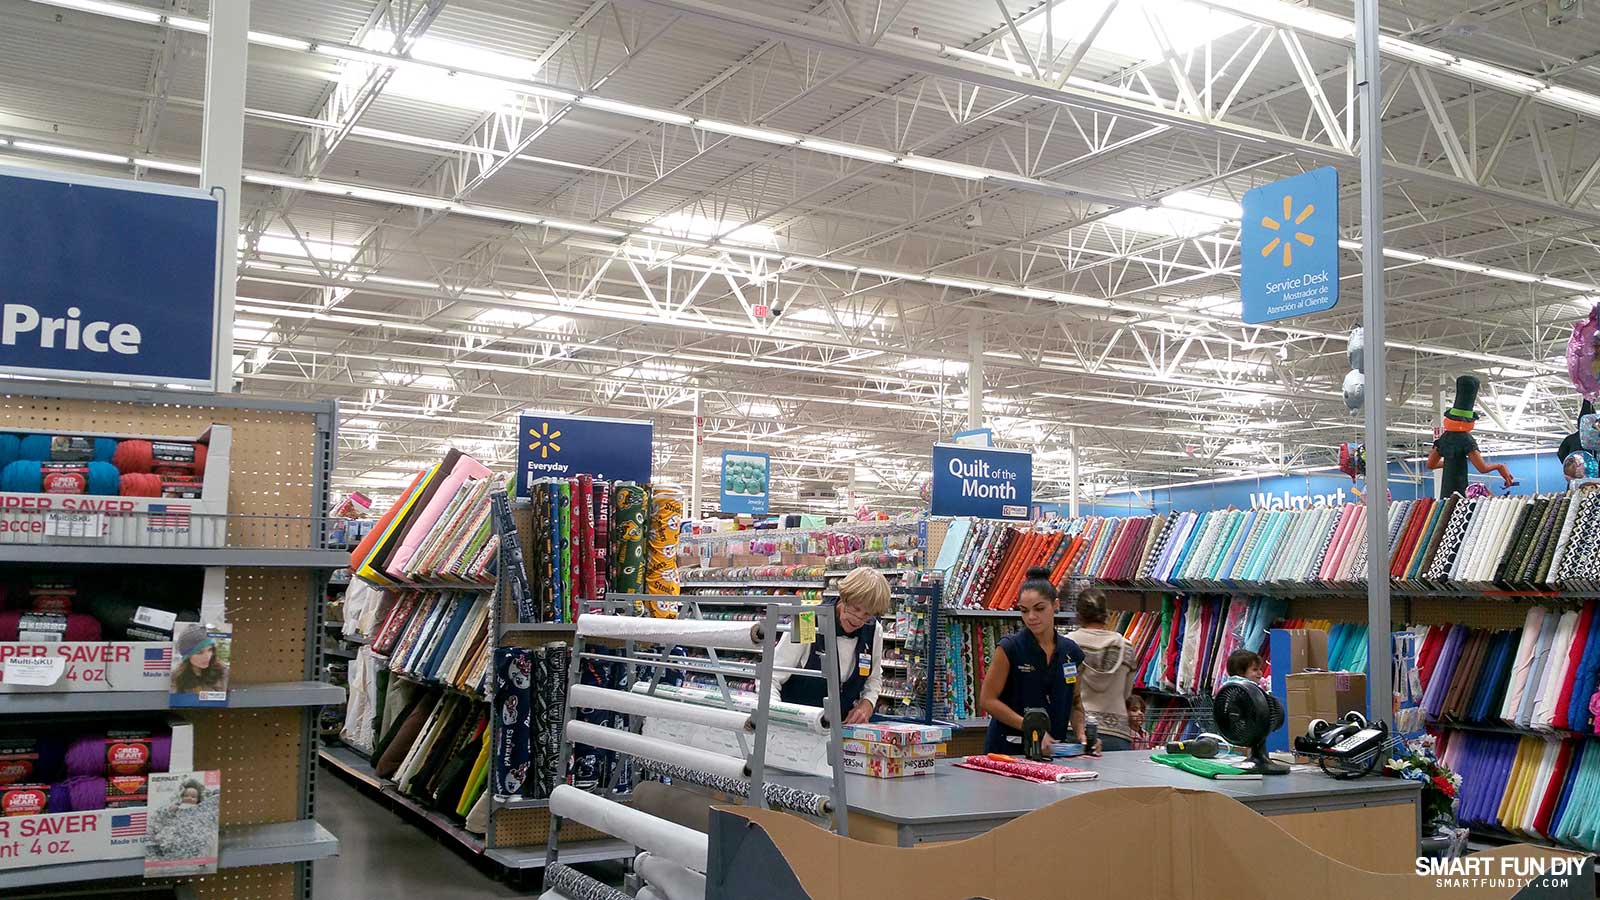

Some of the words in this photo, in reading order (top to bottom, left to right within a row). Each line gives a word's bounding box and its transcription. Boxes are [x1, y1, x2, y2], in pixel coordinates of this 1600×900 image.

[1266, 278, 1300, 295] Service
[1303, 270, 1328, 286] Desk
[1283, 287, 1317, 302] Mostrador
[1319, 286, 1328, 294] de
[1297, 299, 1303, 308] al
[1305, 295, 1329, 306] Cliente
[2, 303, 142, 355] Price
[527, 461, 569, 473] Everyday
[949, 458, 990, 479] Quilt
[991, 468, 1001, 479] of
[1002, 470, 1017, 480] the
[962, 479, 1016, 500] Month
[1250, 488, 1346, 511] Walmart
[0, 496, 52, 514] PER
[62, 497, 135, 517] SAVER
[57, 645, 130, 662] SAVER
[66, 665, 77, 681] 4
[20, 814, 97, 837] SAVER
[30, 838, 42, 856] 4
[48, 840, 74, 854] oz.
